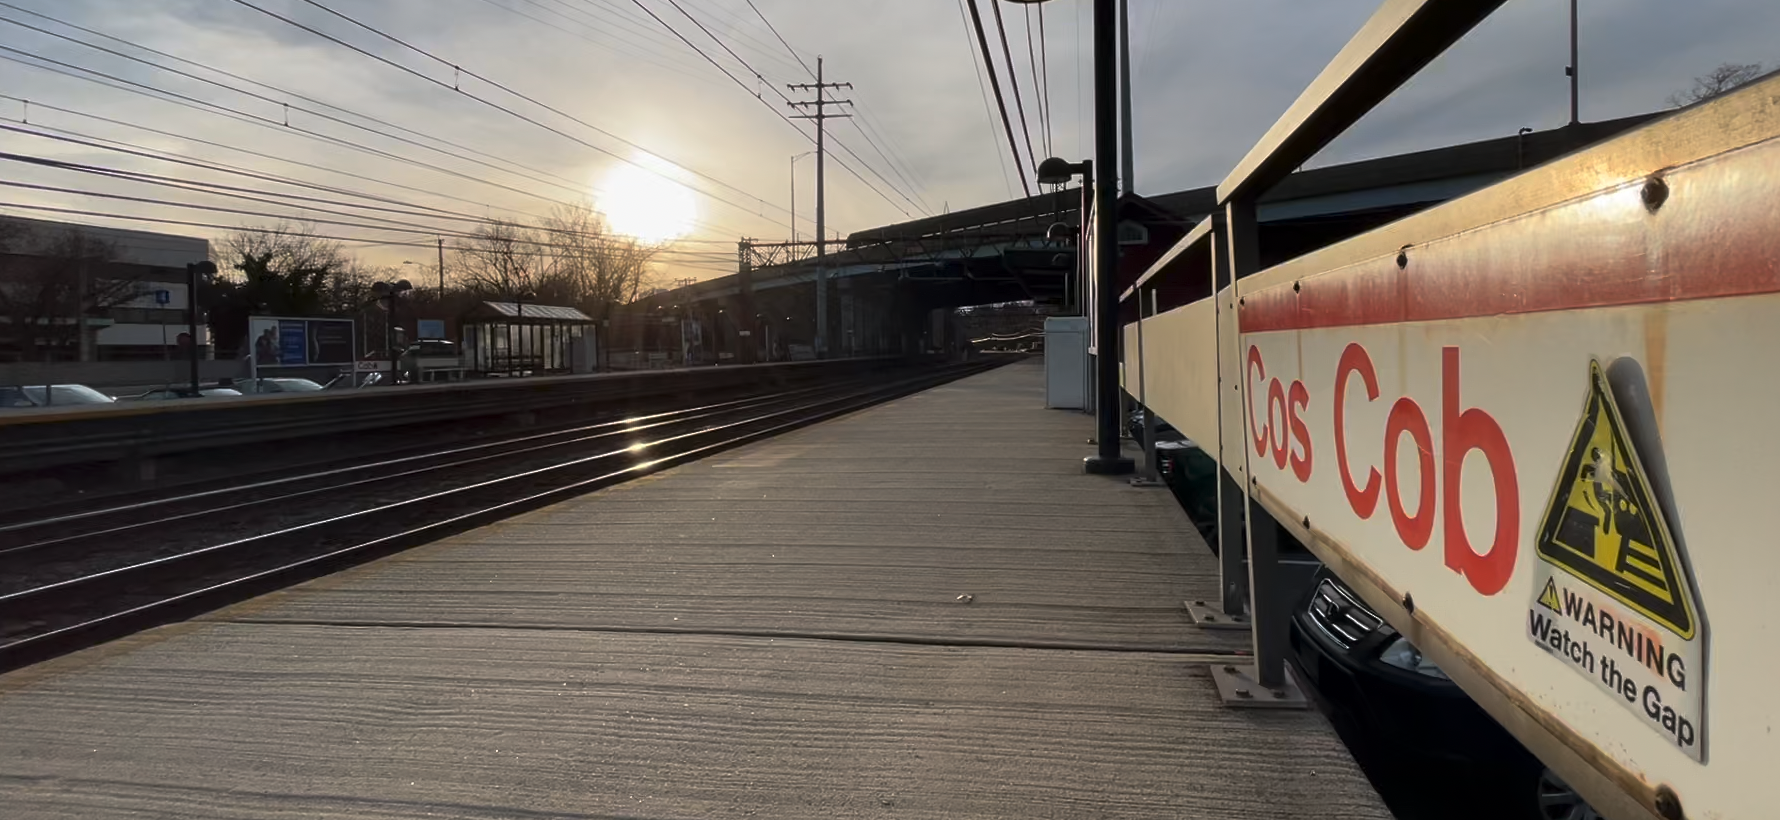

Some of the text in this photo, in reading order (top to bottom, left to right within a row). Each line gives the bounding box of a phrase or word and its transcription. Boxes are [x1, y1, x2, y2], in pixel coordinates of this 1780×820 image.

[1247, 342, 1520, 596] Cos Cob
[1529, 609, 1695, 747] Watch the Gap
[1563, 587, 1686, 692] WARNING
